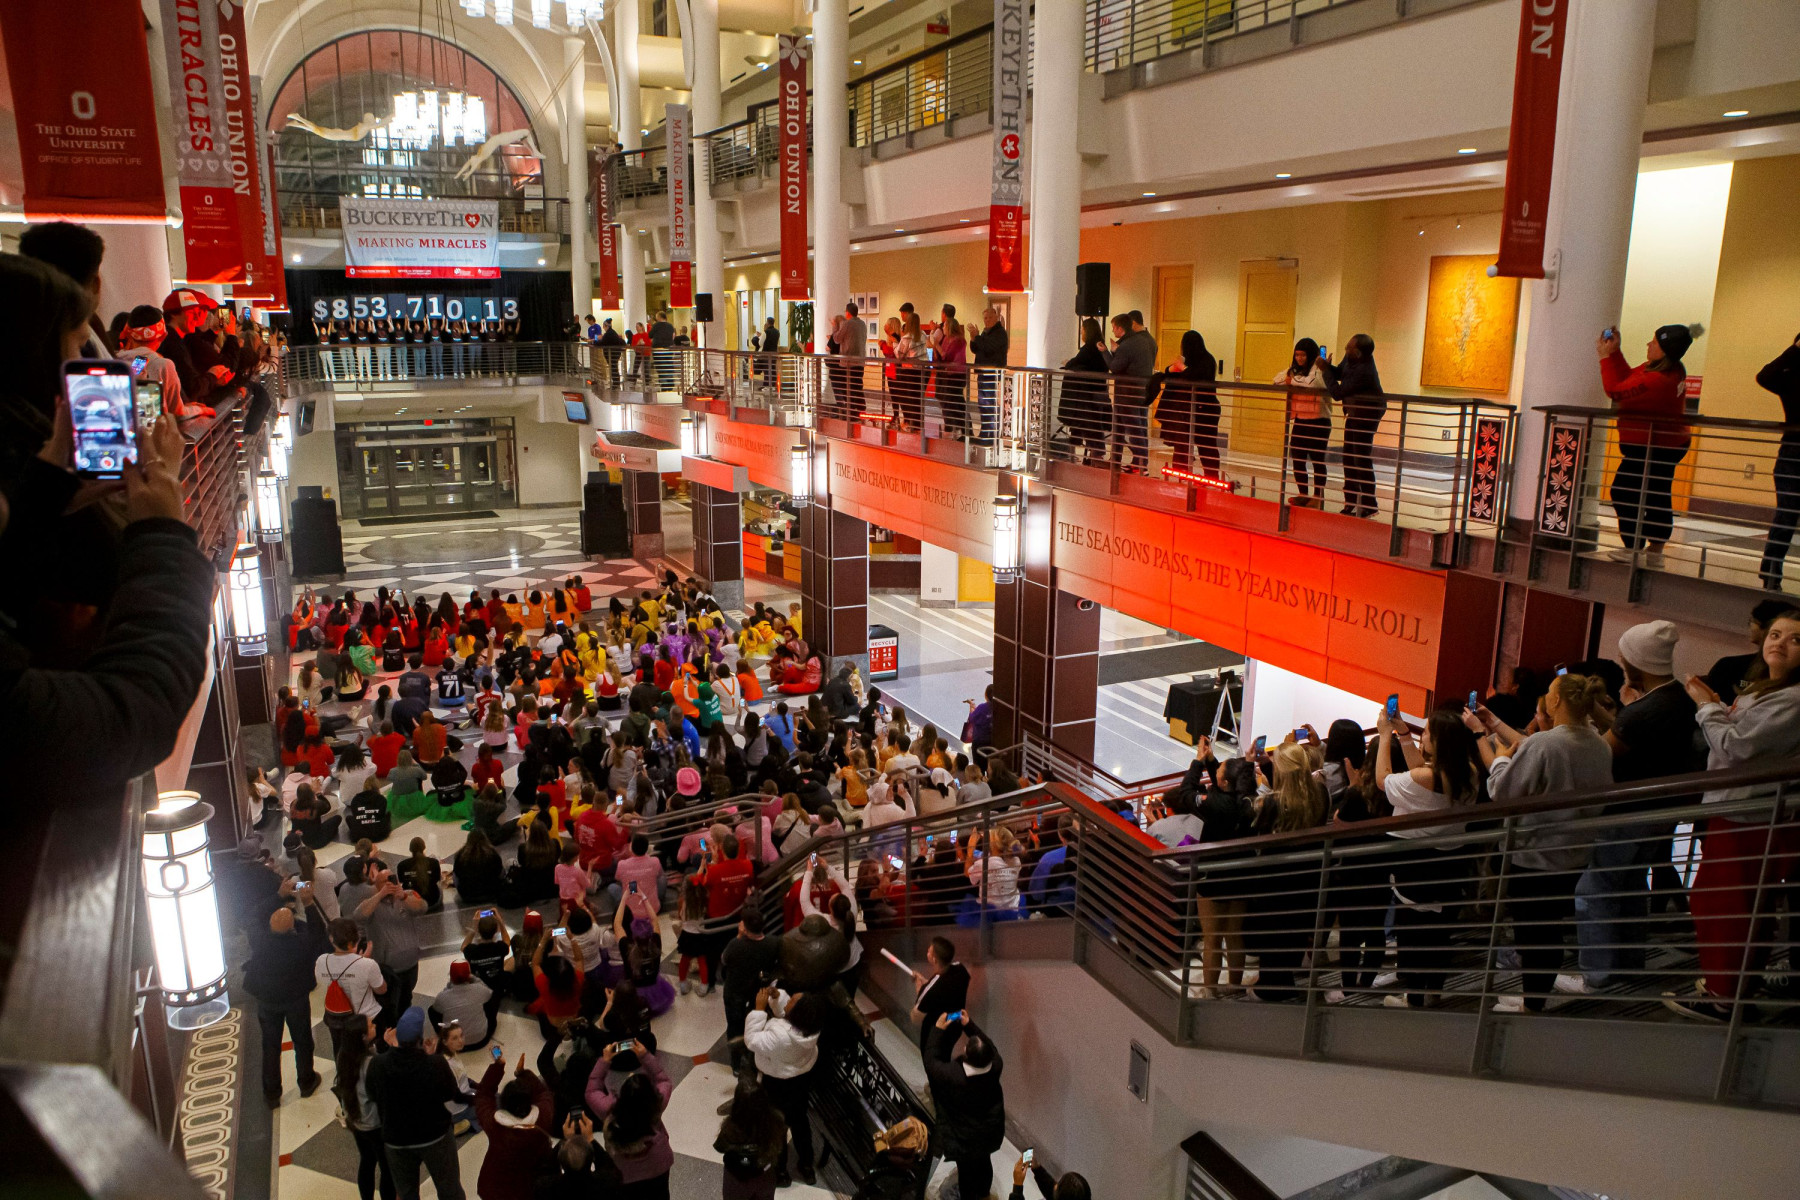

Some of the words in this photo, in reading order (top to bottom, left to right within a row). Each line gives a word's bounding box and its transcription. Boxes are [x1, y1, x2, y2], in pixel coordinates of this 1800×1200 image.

[219, 34, 241, 100] OHIO
[1001, 0, 1022, 182] KEYETHN
[36, 123, 61, 135] THE
[65, 125, 98, 136] OHIO
[100, 126, 136, 137] STATE
[786, 80, 799, 135] OHIO
[50, 137, 125, 150] UNIVERSITY
[84, 156, 122, 165] STUDENT
[125, 157, 142, 165] LIFE
[226, 110, 250, 195] UNION
[672, 119, 683, 174] MAKING
[787, 144, 800, 215] UNION
[601, 212, 612, 256] UNION
[674, 179, 685, 248] MIRACLES
[358, 237, 414, 248] MAKING
[419, 238, 487, 249] MIRACLES
[835, 462, 851, 480] TIME
[852, 467, 868, 484] AND
[868, 472, 900, 493] CHANGE
[900, 482, 921, 499] WILL
[922, 486, 959, 510] SURELY
[959, 495, 989, 516] SHOW
[1058, 521, 1084, 546] THE
[1087, 529, 1150, 565] SEASONS
[1153, 547, 1193, 581] PASS,
[1195, 558, 1231, 588] THE
[1235, 568, 1299, 608] YEARS
[1303, 587, 1358, 626] WILL
[1363, 603, 1429, 646] ROLL
[443, 681, 460, 697] 71
